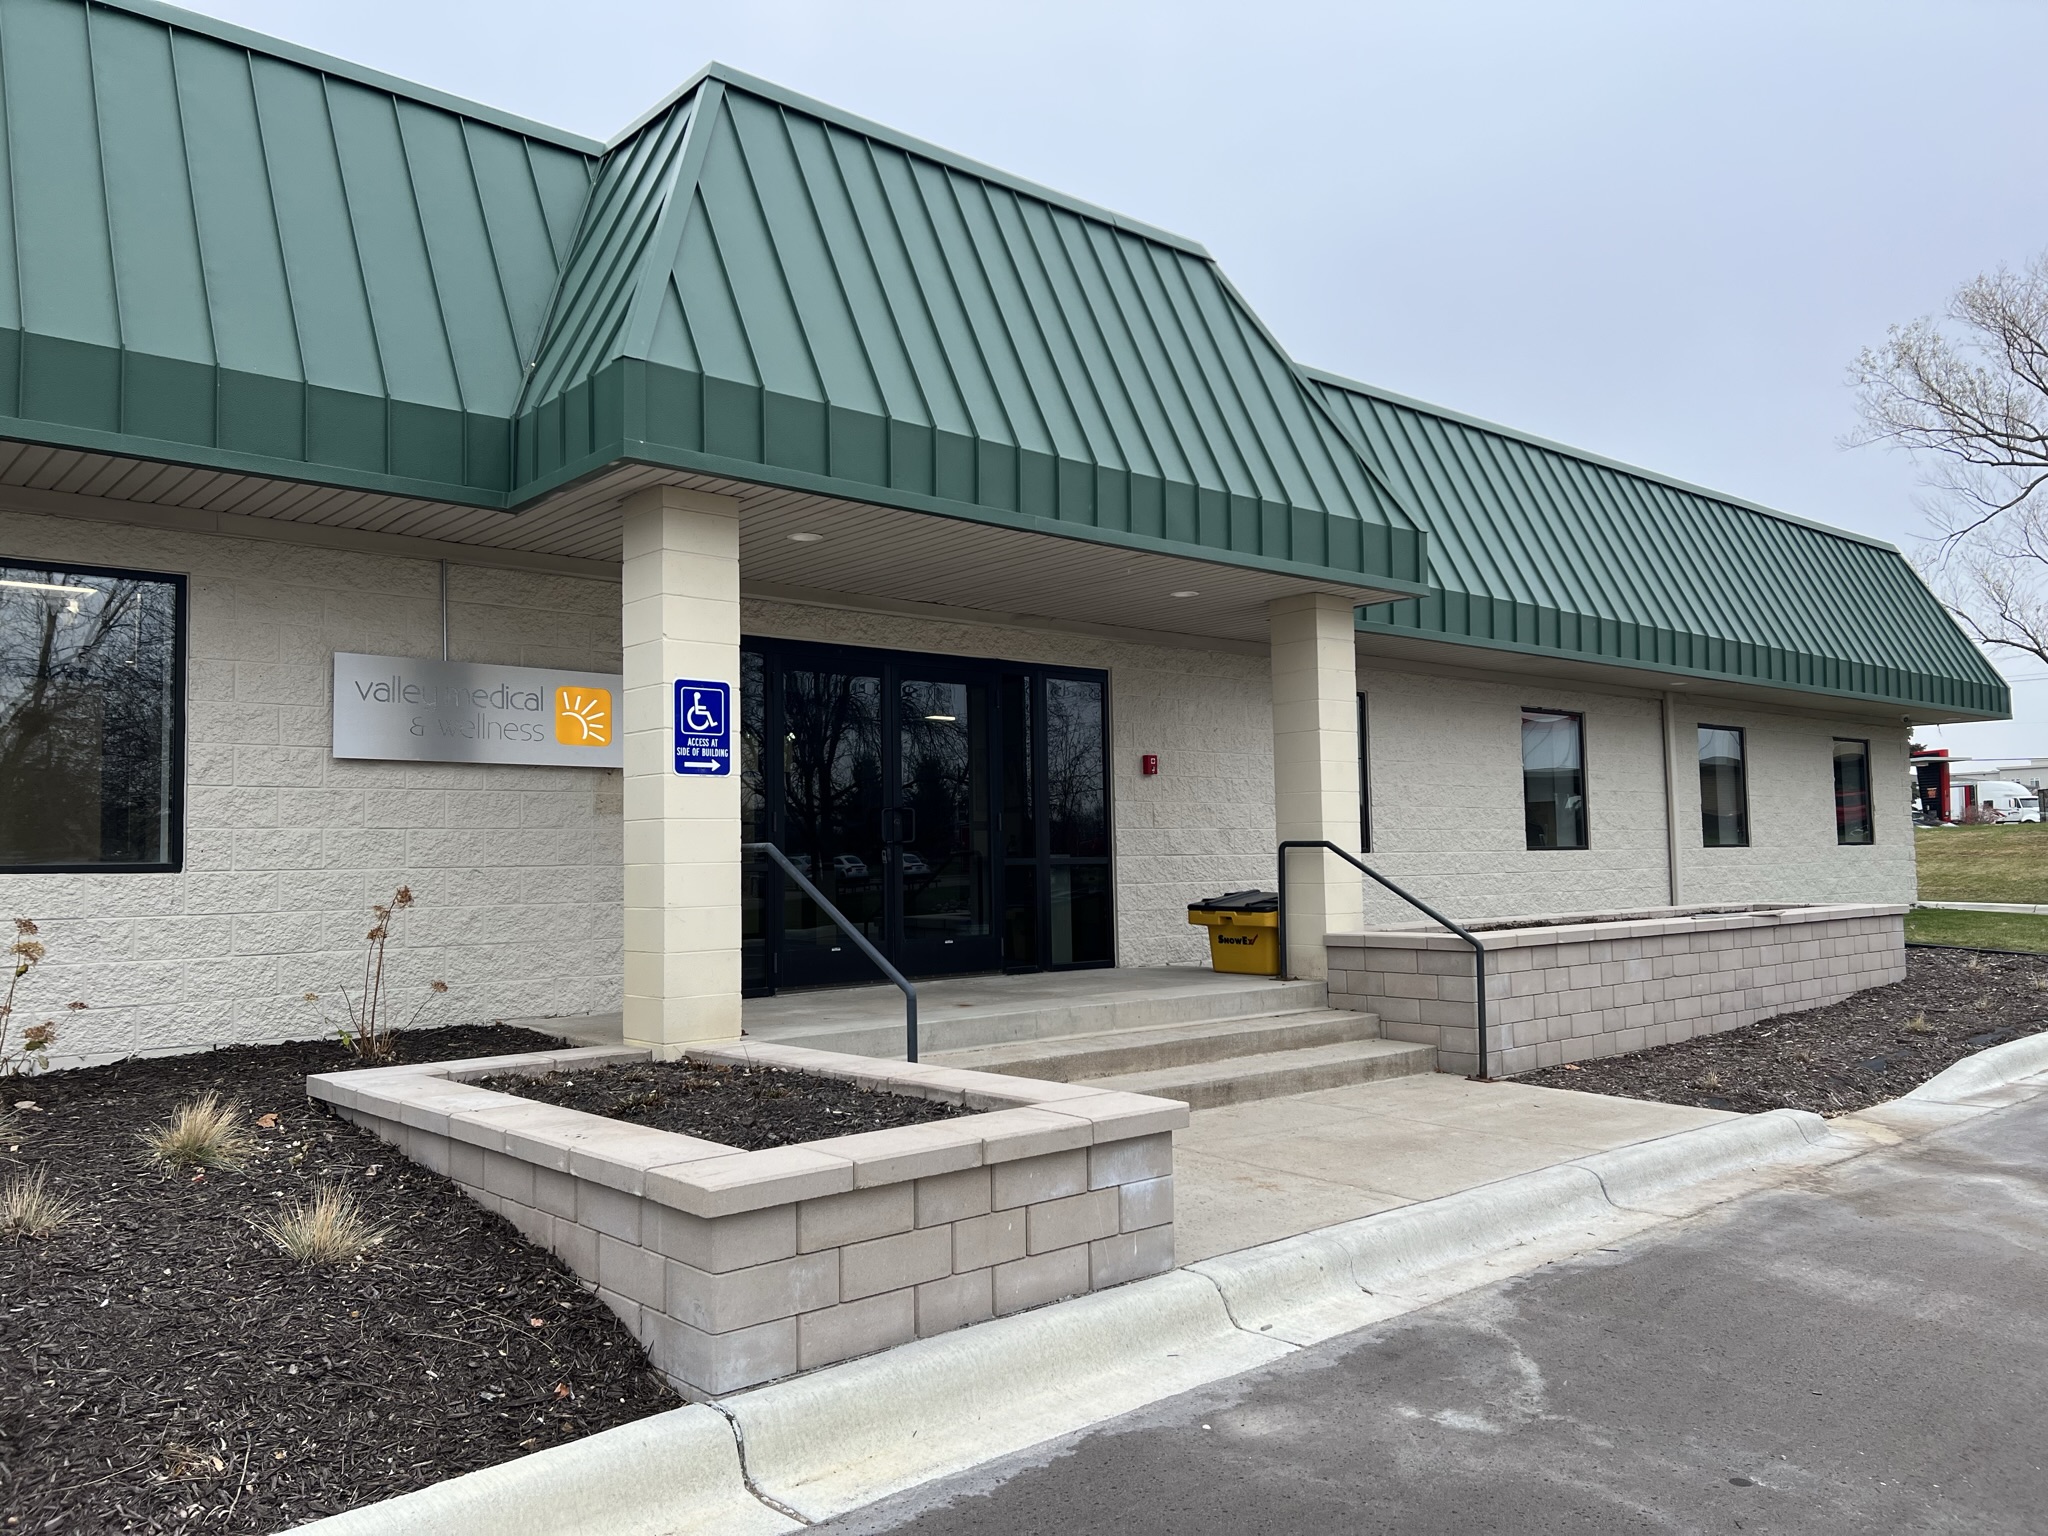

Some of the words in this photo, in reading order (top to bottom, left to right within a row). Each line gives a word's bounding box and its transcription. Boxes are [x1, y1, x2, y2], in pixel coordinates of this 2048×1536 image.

[354, 675, 438, 712] valley
[446, 682, 545, 712] medical
[409, 716, 425, 737] &
[438, 712, 545, 742] wellness
[676, 747, 690, 756] SIDE
[691, 748, 700, 756] OF
[701, 748, 729, 757] BUILDING
[687, 737, 709, 747] ACCESS
[711, 738, 719, 747] AT
